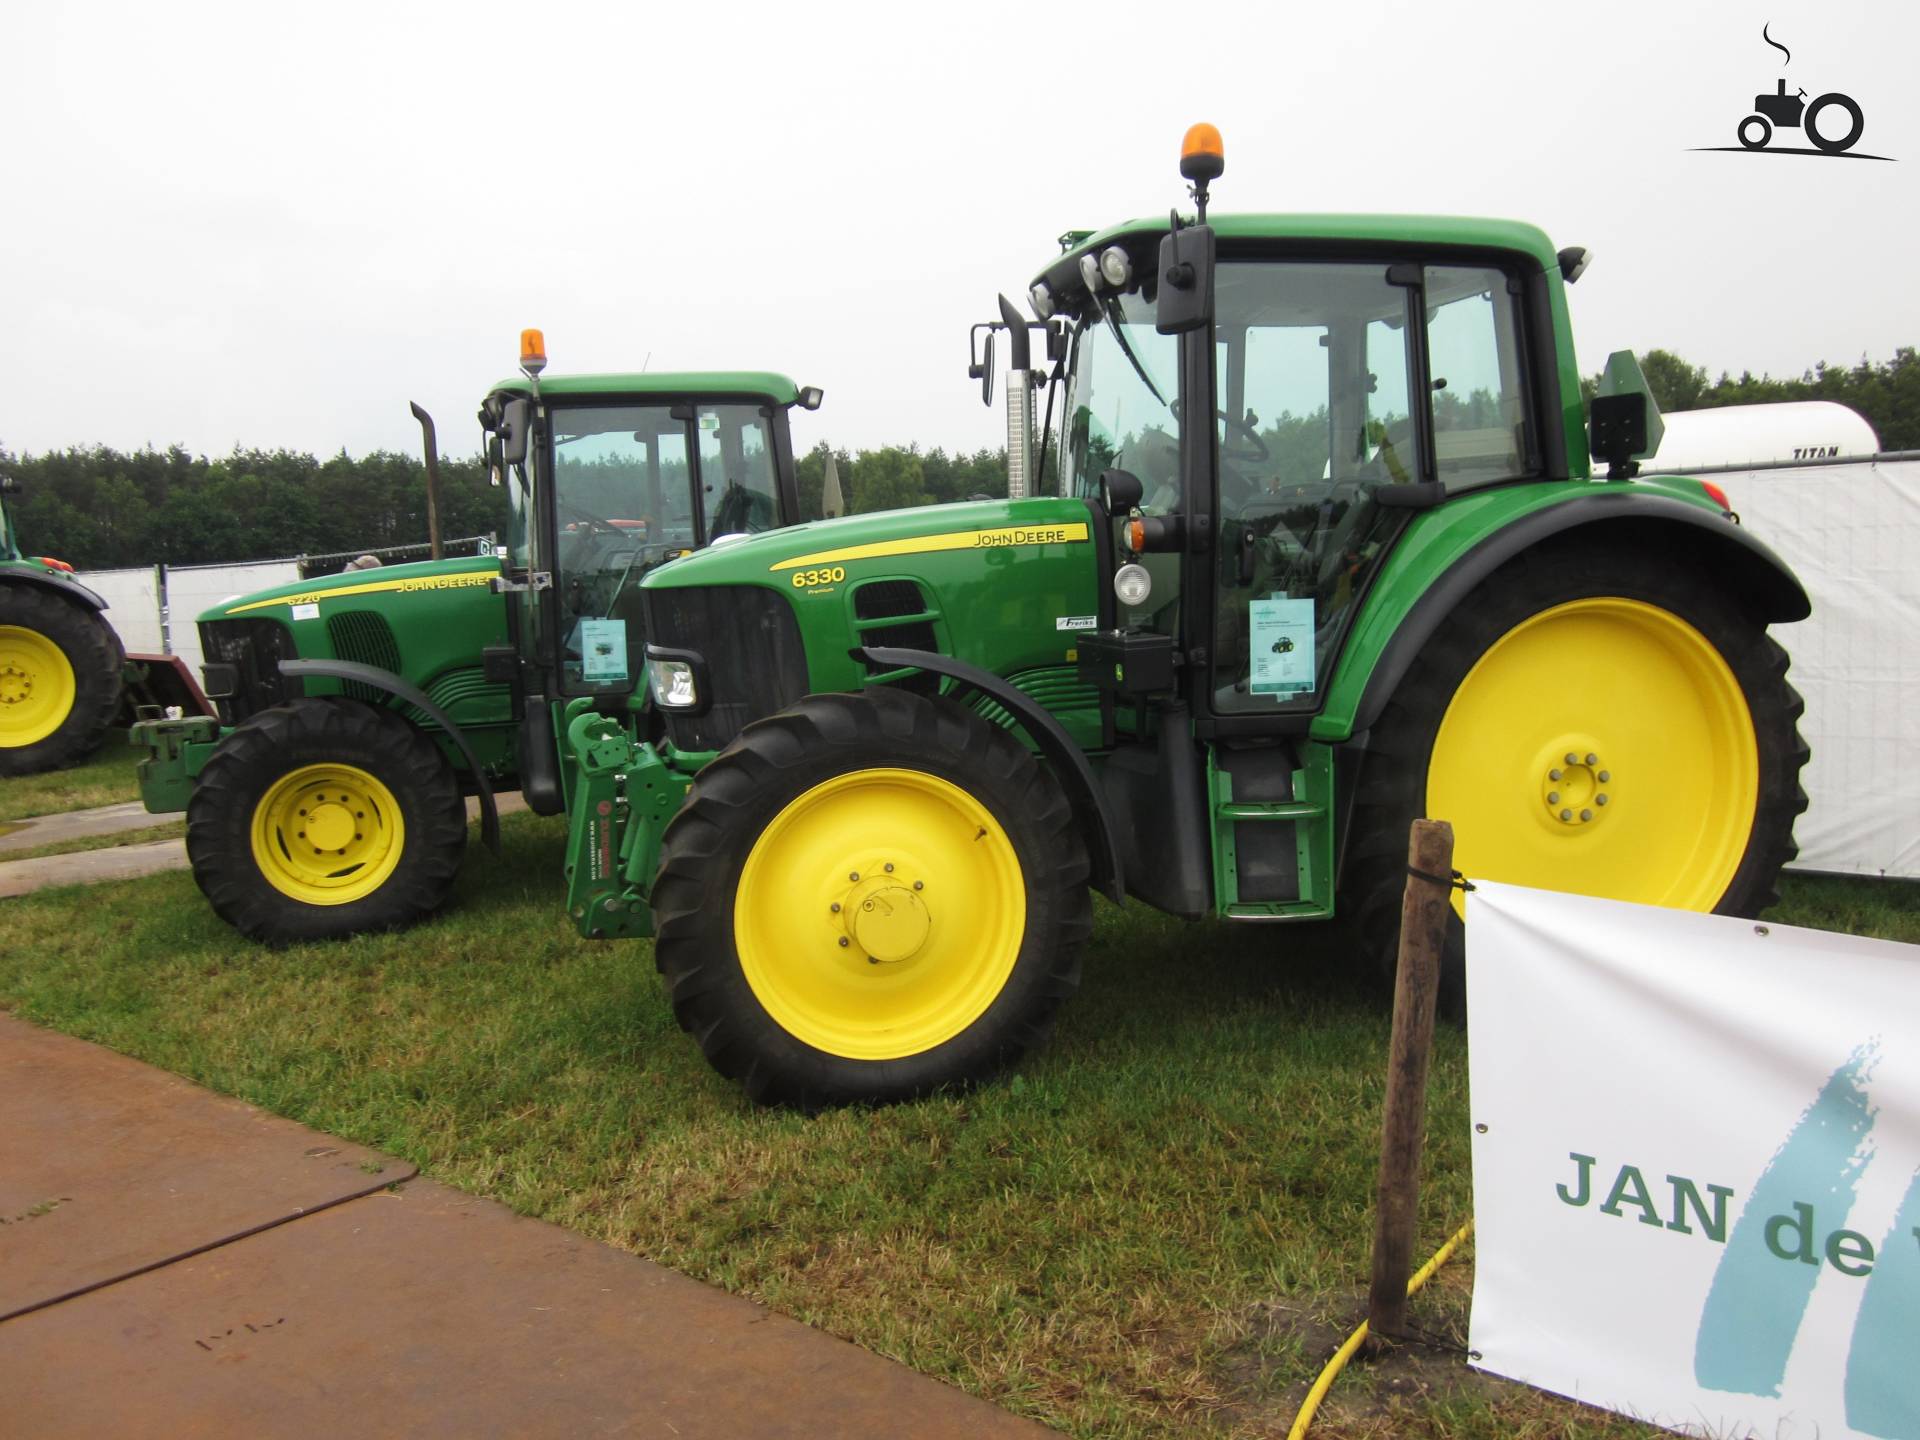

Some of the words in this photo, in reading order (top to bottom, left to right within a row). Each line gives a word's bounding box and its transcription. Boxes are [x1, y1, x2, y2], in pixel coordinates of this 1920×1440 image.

[1794, 446, 1839, 460] TITAN
[974, 532, 1012, 547] JOHN
[1015, 530, 1066, 544] DEERE
[396, 580, 434, 593] JOHN
[437, 576, 486, 588] DEERE
[792, 566, 845, 588] 6330
[1555, 1151, 1735, 1244] JAN
[1763, 1201, 1876, 1277] de
